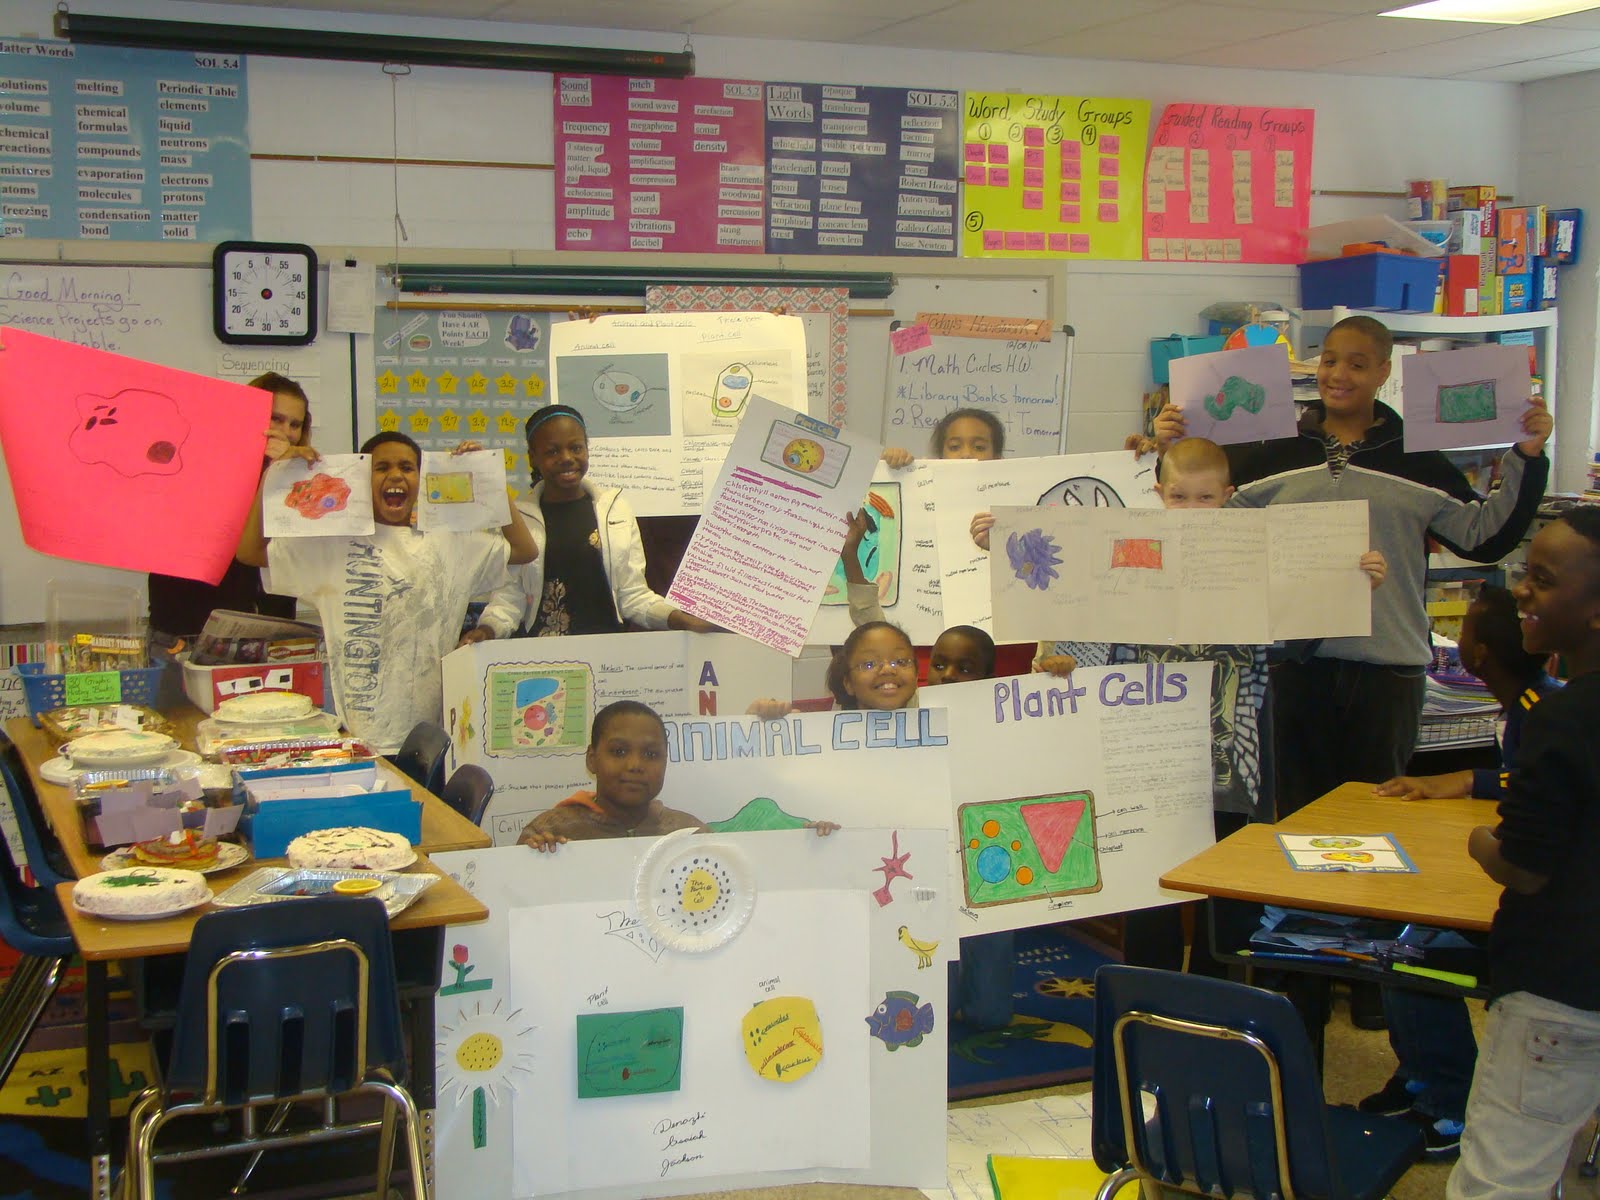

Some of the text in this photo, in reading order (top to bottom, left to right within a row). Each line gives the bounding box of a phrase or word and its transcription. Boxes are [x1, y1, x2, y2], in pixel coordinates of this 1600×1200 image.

[35, 44, 74, 58] Words
[195, 57, 238, 69] SOL 5.4
[77, 82, 119, 94] melting
[159, 82, 237, 97] Periodic Table
[561, 80, 589, 91] Sound
[630, 80, 651, 90] pitch
[725, 85, 745, 95] SOL
[562, 93, 590, 105] Words
[769, 87, 800, 103] Light
[909, 93, 938, 106] SOL
[0, 104, 40, 113] volume
[160, 101, 207, 111] elements
[630, 102, 676, 111] sound wave
[77, 107, 126, 118] chemical
[770, 105, 812, 119] Words
[1022, 97, 1065, 127] Study
[1077, 99, 1132, 127] Groups
[159, 120, 191, 132] liquid
[1211, 105, 1253, 137] Reading
[1259, 107, 1306, 135] Groups
[78, 121, 128, 133] formulas
[565, 123, 608, 134] frequency
[630, 122, 674, 132] megaphone
[696, 126, 718, 134] sonar
[0, 129, 50, 140] chemical
[160, 138, 208, 148] neutrons
[631, 141, 660, 149] volume
[695, 142, 726, 153] density
[0, 143, 51, 154] reactions
[78, 146, 141, 158] compounds
[160, 155, 187, 165] mass
[630, 158, 675, 167] amplification
[1, 166, 51, 177] mixtures
[823, 165, 849, 174] trough
[78, 169, 144, 181] evaporation
[566, 176, 578, 184] gas
[161, 176, 209, 186] electrons
[632, 176, 675, 185] compression
[901, 177, 955, 191] Robert Hooke
[1, 185, 36, 195] atoms
[772, 183, 795, 194] prism
[821, 182, 845, 192] lenses
[78, 190, 132, 201] molecules
[163, 193, 204, 204] protons
[633, 194, 656, 202] sound
[722, 191, 760, 200] woodwind
[2, 206, 49, 218] freezing
[567, 206, 611, 218] amplitude
[633, 206, 659, 215] energy
[821, 202, 860, 212] plane lens
[79, 210, 151, 222] condensation
[163, 213, 198, 222] matter
[721, 208, 760, 218] percussion
[4, 225, 23, 235] gas
[630, 221, 672, 231] vibrations
[852, 221, 867, 229] lens
[81, 226, 109, 236] bond
[164, 226, 189, 237] solid
[567, 230, 588, 238] echo
[632, 239, 660, 247] decibel
[897, 239, 947, 250] Isaac Newton
[249, 260, 253, 268] 5
[265, 257, 269, 265] 0
[280, 261, 288, 269] 55
[233, 272, 241, 280] 10
[292, 274, 301, 282] 50
[7, 271, 52, 300] Good
[228, 289, 237, 297] 15
[296, 291, 305, 299] 45
[232, 305, 241, 313] 20
[0, 304, 162, 333] Science Projects go on
[245, 319, 254, 327] 25
[262, 323, 271, 331] 30
[280, 320, 288, 328] 35
[222, 352, 290, 376] Sequencing
[912, 354, 960, 375] Math
[966, 353, 1002, 374] Circles
[962, 384, 1008, 404] Books
[344, 540, 383, 712] HUNTINGTON
[994, 663, 1188, 723] Plant Cells
[832, 708, 948, 750] CELL
[596, 910, 640, 930] The
